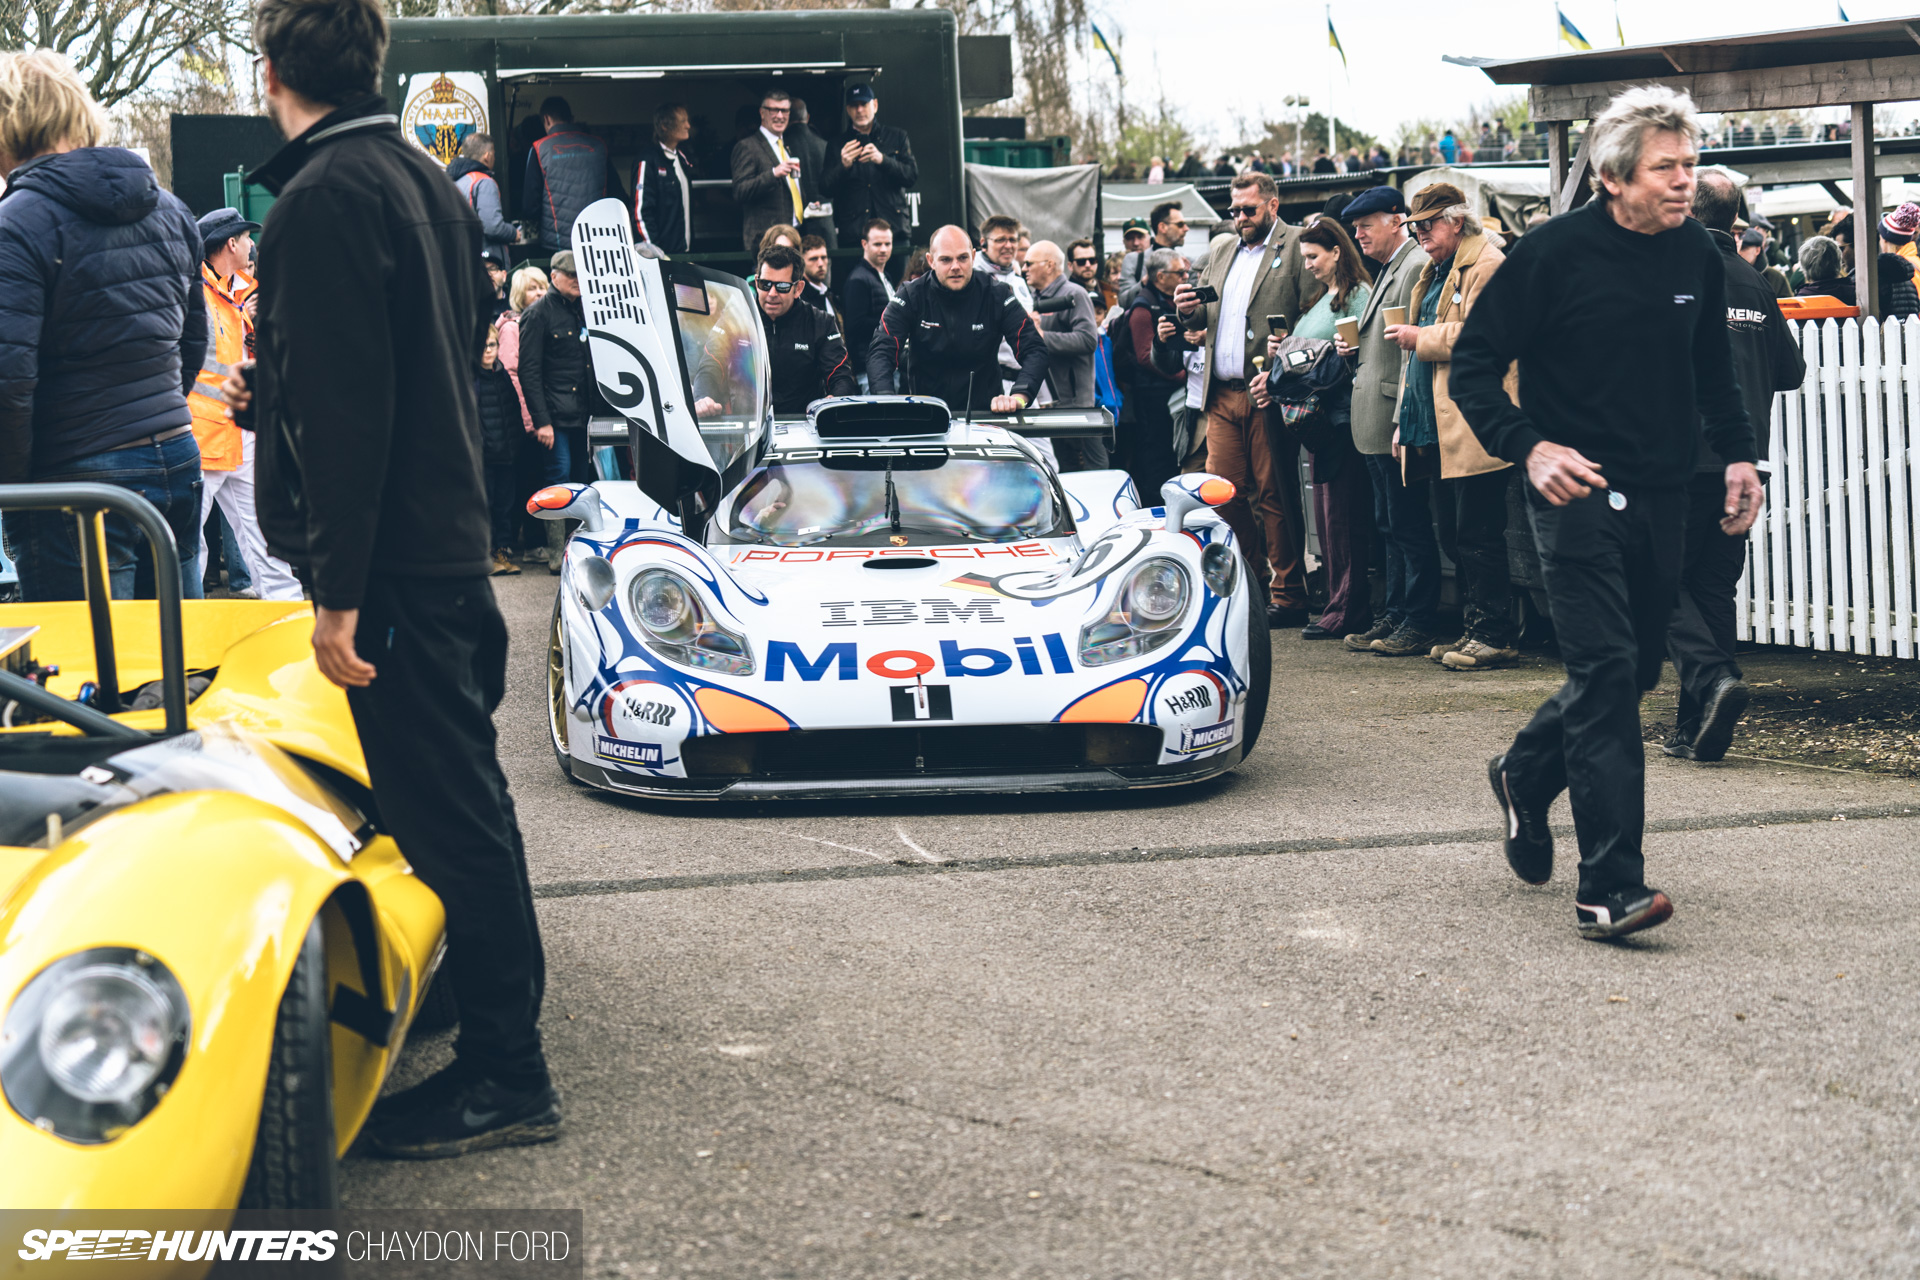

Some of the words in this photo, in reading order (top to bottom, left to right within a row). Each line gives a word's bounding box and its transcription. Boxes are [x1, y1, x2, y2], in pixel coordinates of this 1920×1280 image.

[475, 112, 485, 133] INST
[577, 222, 646, 326] IBM
[763, 448, 1025, 461] PORSCHE
[742, 543, 1051, 563] PORSCHE
[820, 598, 1005, 627] IBM
[764, 632, 1074, 682] Mobil
[904, 686, 931, 719] 1
[1193, 724, 1234, 747] MICHELIN
[600, 740, 660, 762] MICHELIN
